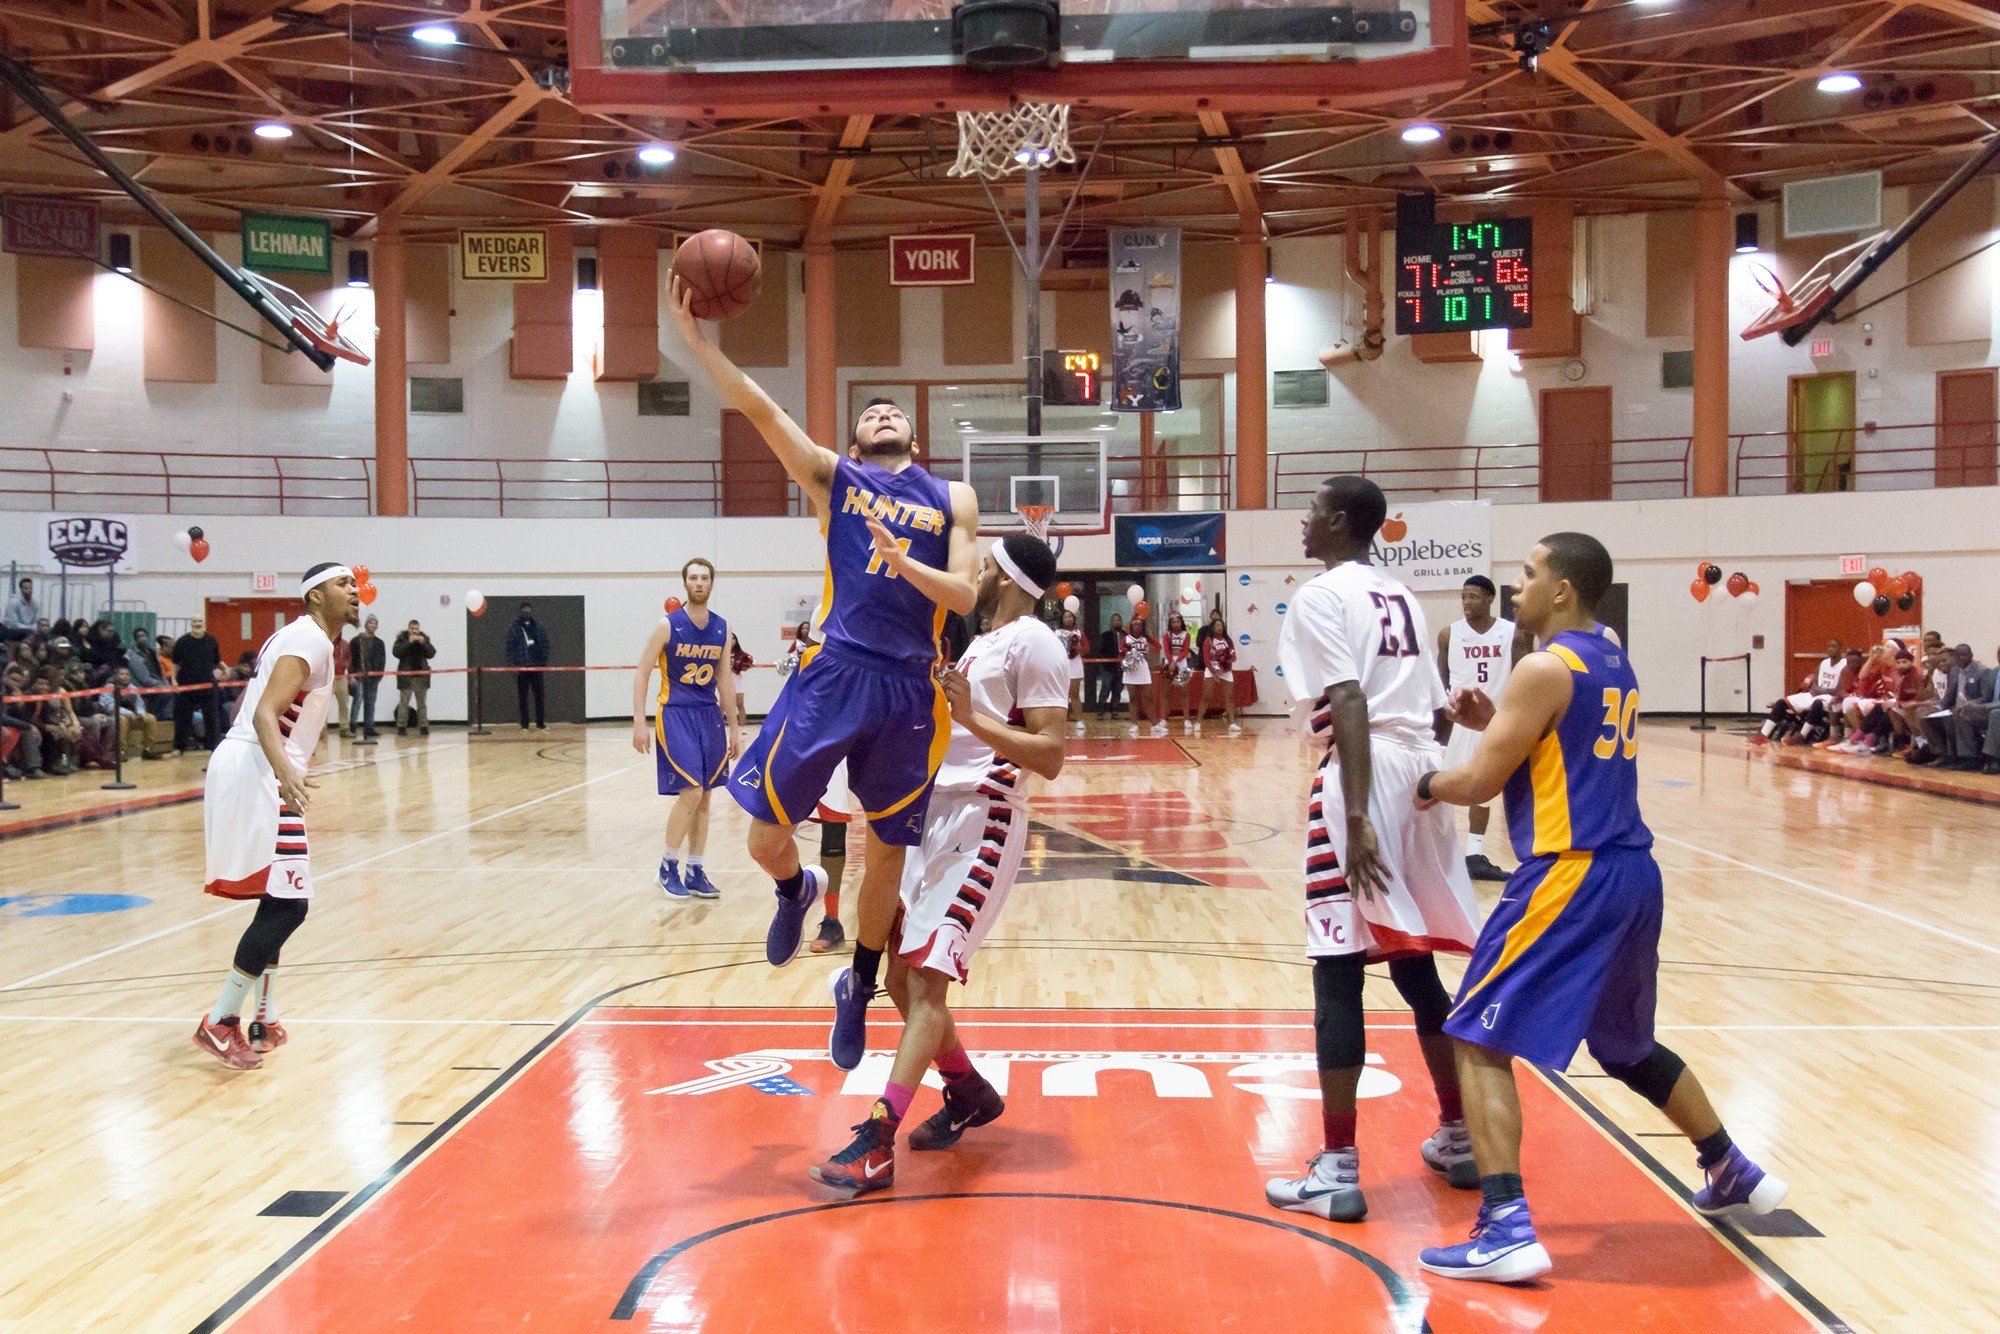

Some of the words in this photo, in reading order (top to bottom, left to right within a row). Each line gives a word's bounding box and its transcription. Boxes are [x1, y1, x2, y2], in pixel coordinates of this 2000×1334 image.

[250, 231, 324, 257] LEHMAN
[468, 237, 539, 254] MEDGAR
[905, 249, 960, 270] YORK
[1404, 255, 1432, 264] HOME
[1449, 253, 1476, 261] PERIOD
[1492, 249, 1524, 259] GUEST
[478, 256, 531, 272] EVERS
[1406, 264, 1438, 288] 71
[1450, 277, 1475, 285] BONUS
[1437, 288, 1465, 296] PLAYER
[1505, 284, 1529, 292] FOULS
[1406, 299, 1421, 323] 7
[1445, 296, 1467, 322] 10
[1485, 295, 1491, 319] 1
[1513, 292, 1529, 314] 9
[1812, 341, 1830, 355] EXIT
[1065, 354, 1099, 370] 1:47
[1075, 372, 1091, 399] 7
[841, 486, 946, 536] HUNTER
[50, 520, 126, 547] ECAC
[1163, 536, 1192, 545] Division
[1369, 539, 1482, 567] Applebee's
[1414, 568, 1441, 577] GRILL
[1444, 567, 1450, 576] &
[1453, 567, 1473, 576] BAR
[1843, 558, 1863, 573] EXIT
[257, 575, 275, 588] EXIT
[675, 643, 723, 660] HUNTER
[1463, 645, 1502, 659] YORK
[680, 662, 714, 686] 20
[1477, 662, 1488, 683] 5
[1593, 687, 1639, 760] 30
[286, 870, 304, 890] YC
[1320, 918, 1345, 944] YC
